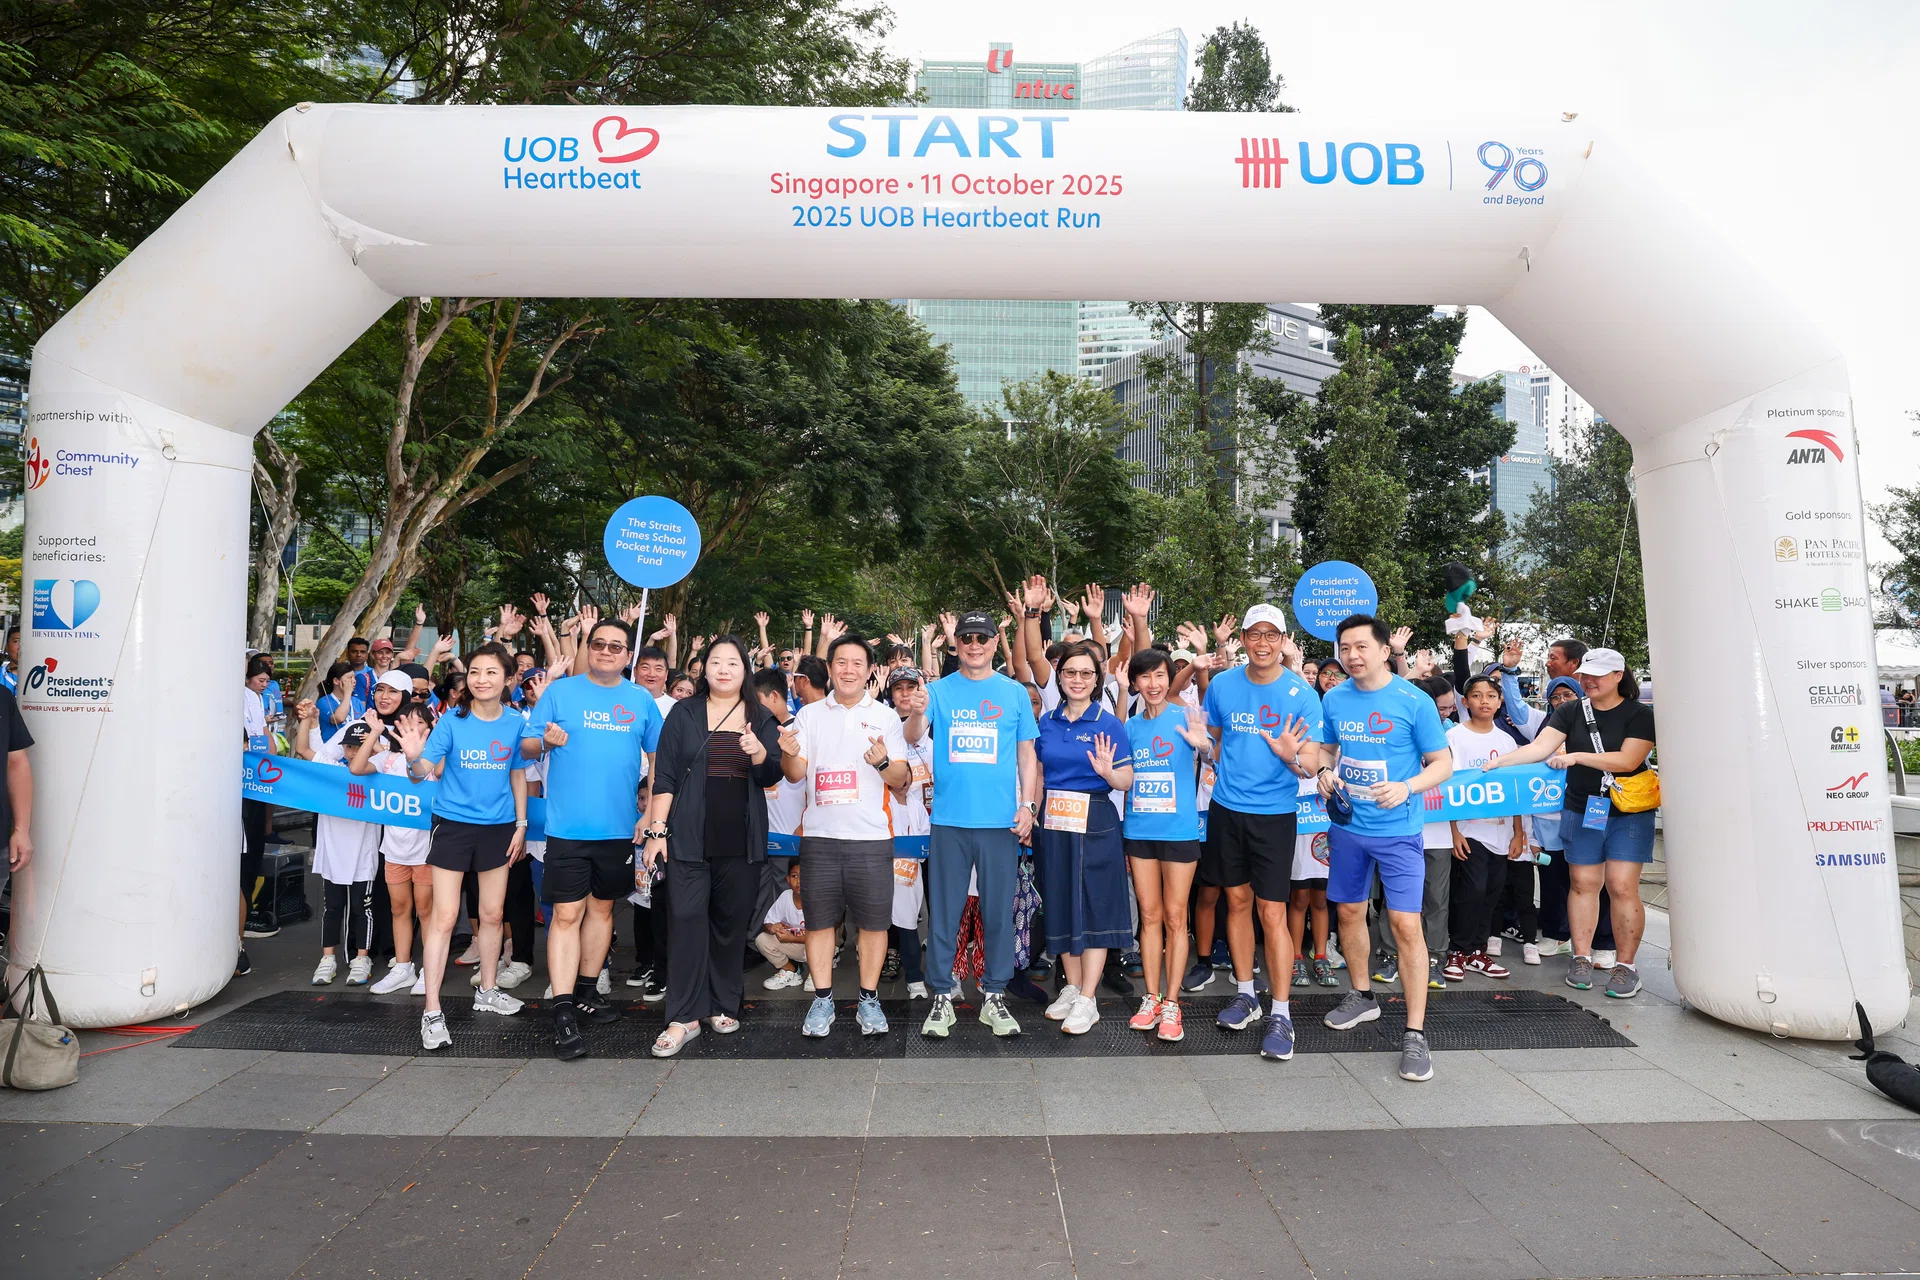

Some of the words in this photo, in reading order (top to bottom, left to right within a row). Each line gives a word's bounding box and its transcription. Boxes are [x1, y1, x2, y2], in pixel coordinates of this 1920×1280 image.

[1015, 79, 1075, 100] ntuc
[827, 114, 1069, 158] START
[504, 137, 579, 162] UOB
[1516, 147, 1544, 155] Years
[1298, 142, 1424, 185] UOB
[504, 166, 641, 189] Heartbeat
[770, 172, 899, 199] Singapore
[920, 174, 942, 194] 11
[951, 173, 1055, 195] October
[1061, 174, 1123, 196] 2025
[1483, 195, 1503, 204] and
[1506, 195, 1544, 206] Beyond
[792, 206, 851, 227] 2025
[860, 206, 914, 227] UOB
[923, 206, 1049, 228] Heartbeat
[1057, 207, 1101, 228] Run
[36, 410, 94, 423] partnership
[99, 412, 132, 424] with:
[1767, 408, 1815, 418] Platinum
[56, 450, 139, 468] Community
[1787, 448, 1825, 464] ANTA
[56, 464, 93, 476] Chest
[1785, 510, 1811, 520] Gold
[628, 518, 646, 528] The
[649, 521, 682, 533] Straits
[38, 535, 96, 547] Supported
[621, 529, 650, 541] Times
[652, 533, 686, 545] School
[616, 540, 650, 553] Pocket
[652, 545, 687, 559] Money
[1804, 540, 1828, 549] PAN
[1832, 539, 1861, 549] PACIFIC
[33, 550, 106, 562] beneficiaries:
[637, 555, 663, 566] Fund
[1805, 551, 1840, 559] HOTELS
[1310, 577, 1359, 586] President's
[1312, 588, 1357, 597] Challenge
[1300, 598, 1330, 607] (SHINE
[1332, 598, 1370, 606] Children
[1775, 597, 1819, 609] SHAKE
[1315, 619, 1341, 627] Servic
[1797, 660, 1827, 669] Silver
[47, 676, 114, 687] President's
[47, 687, 109, 700] Challenge
[1809, 685, 1855, 695] CELLAR
[584, 710, 610, 722] UOB
[952, 709, 977, 720] UOB
[584, 720, 630, 732] Heartbeat
[952, 720, 997, 728] Heartbeat
[1339, 721, 1364, 732] UOB
[957, 736, 989, 749] 0001
[1339, 733, 1386, 744] Heartbeat
[461, 750, 487, 760] UOB
[461, 761, 506, 769] Heartbeat
[912, 766, 926, 777] 43
[1345, 767, 1378, 782] 0953
[819, 772, 851, 786] 9448
[1139, 782, 1169, 793] 8276
[1448, 782, 1505, 807] UOB
[370, 788, 422, 816] UOB
[1050, 800, 1081, 813] A030
[1589, 807, 1605, 815] Crew
[1807, 820, 1874, 831] PRUDENTIAL
[1816, 852, 1886, 866] SAMSUNG
[893, 860, 916, 874] 044
